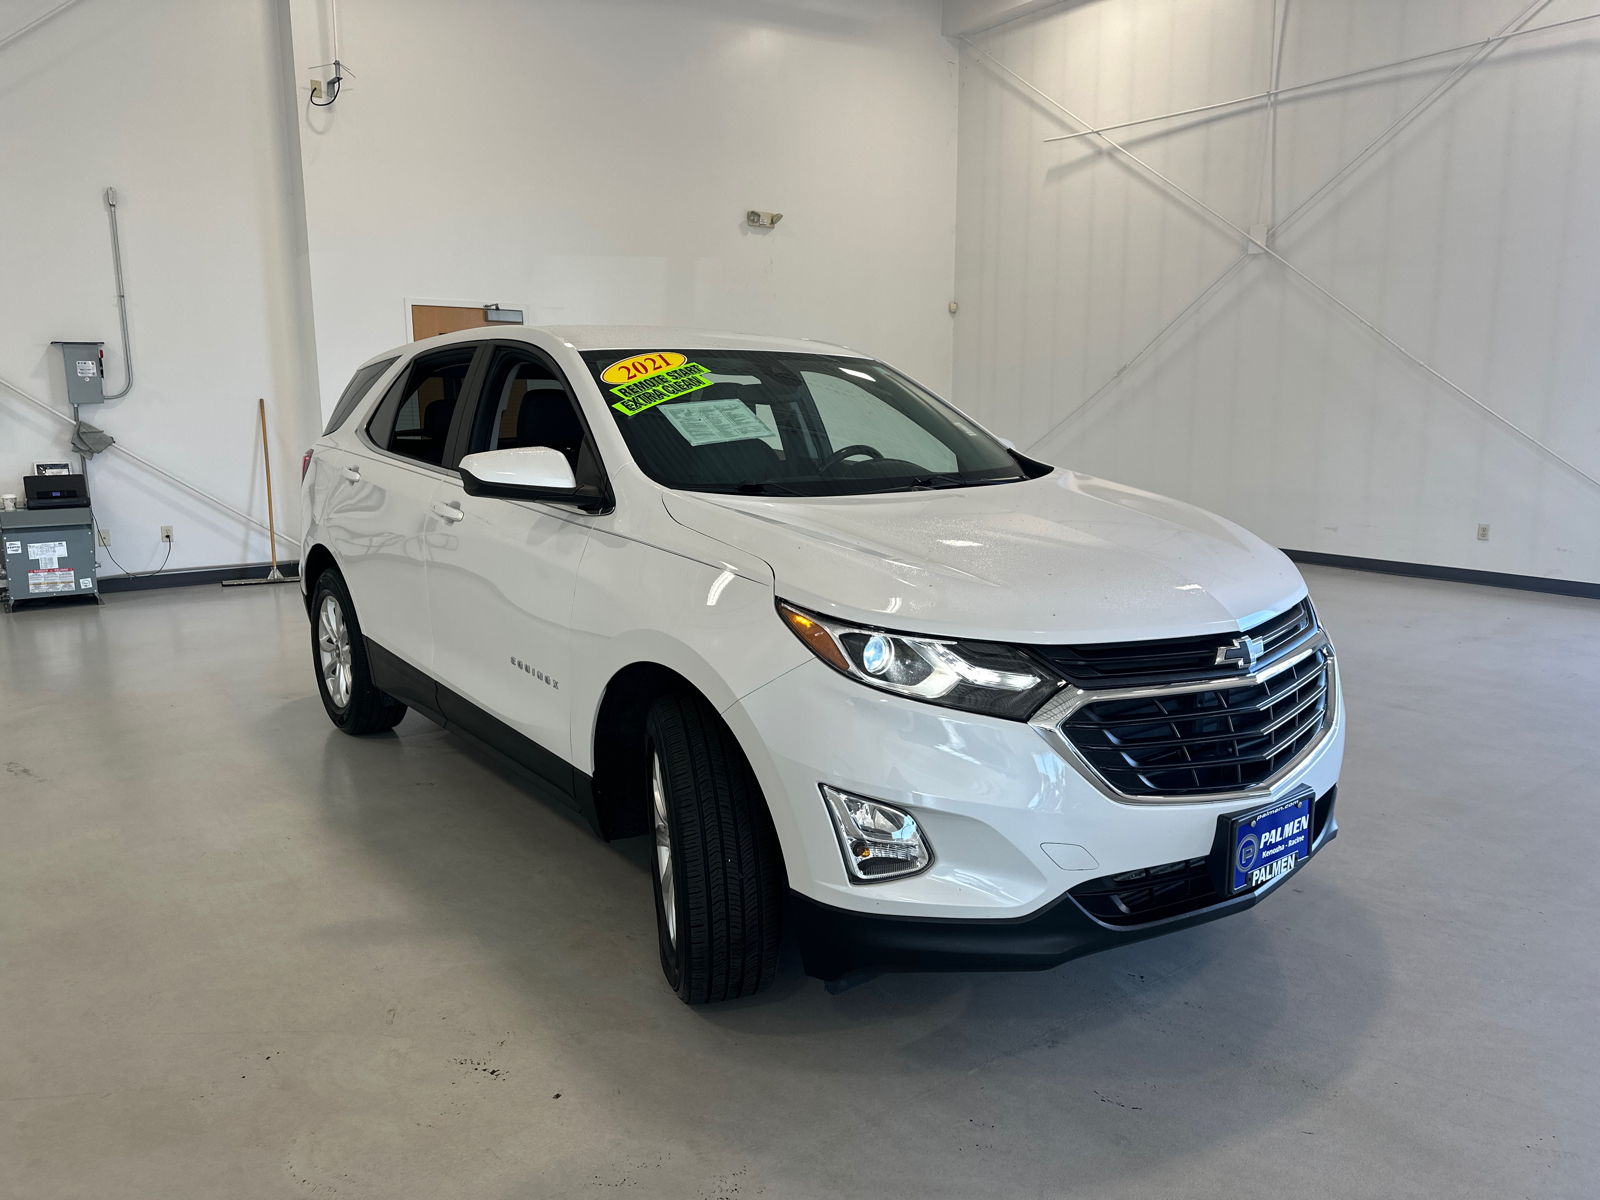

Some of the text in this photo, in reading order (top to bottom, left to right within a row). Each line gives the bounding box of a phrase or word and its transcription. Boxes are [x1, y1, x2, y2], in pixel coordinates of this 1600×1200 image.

[618, 354, 672, 380] 2021
[618, 364, 703, 397] REMOTE START
[620, 374, 704, 412] EXTRA CLEAN
[510, 655, 559, 690] EQUINOX
[1259, 814, 1310, 849] PALMEN
[1261, 843, 1285, 859] Kenosha
[1288, 835, 1304, 848] Racine
[1252, 853, 1295, 887] PALMEN
